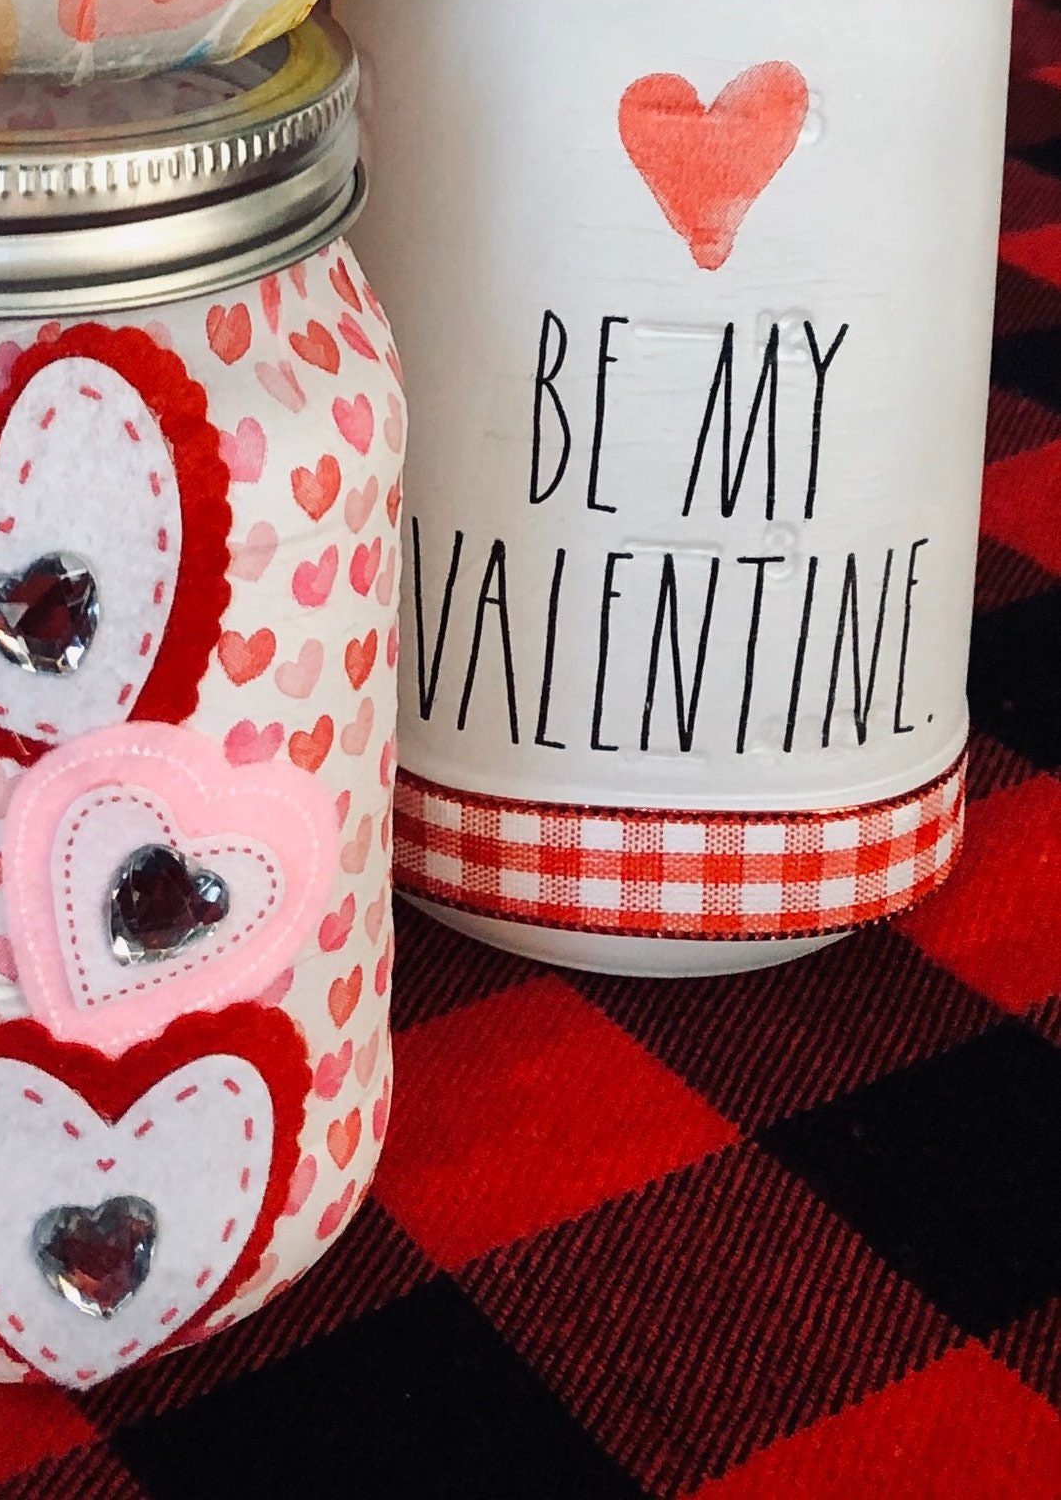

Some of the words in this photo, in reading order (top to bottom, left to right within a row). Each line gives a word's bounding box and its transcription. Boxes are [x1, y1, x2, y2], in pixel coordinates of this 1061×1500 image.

[530, 309, 629, 514] BE
[681, 319, 849, 521] MY
[411, 514, 933, 754] VALENTINE.
